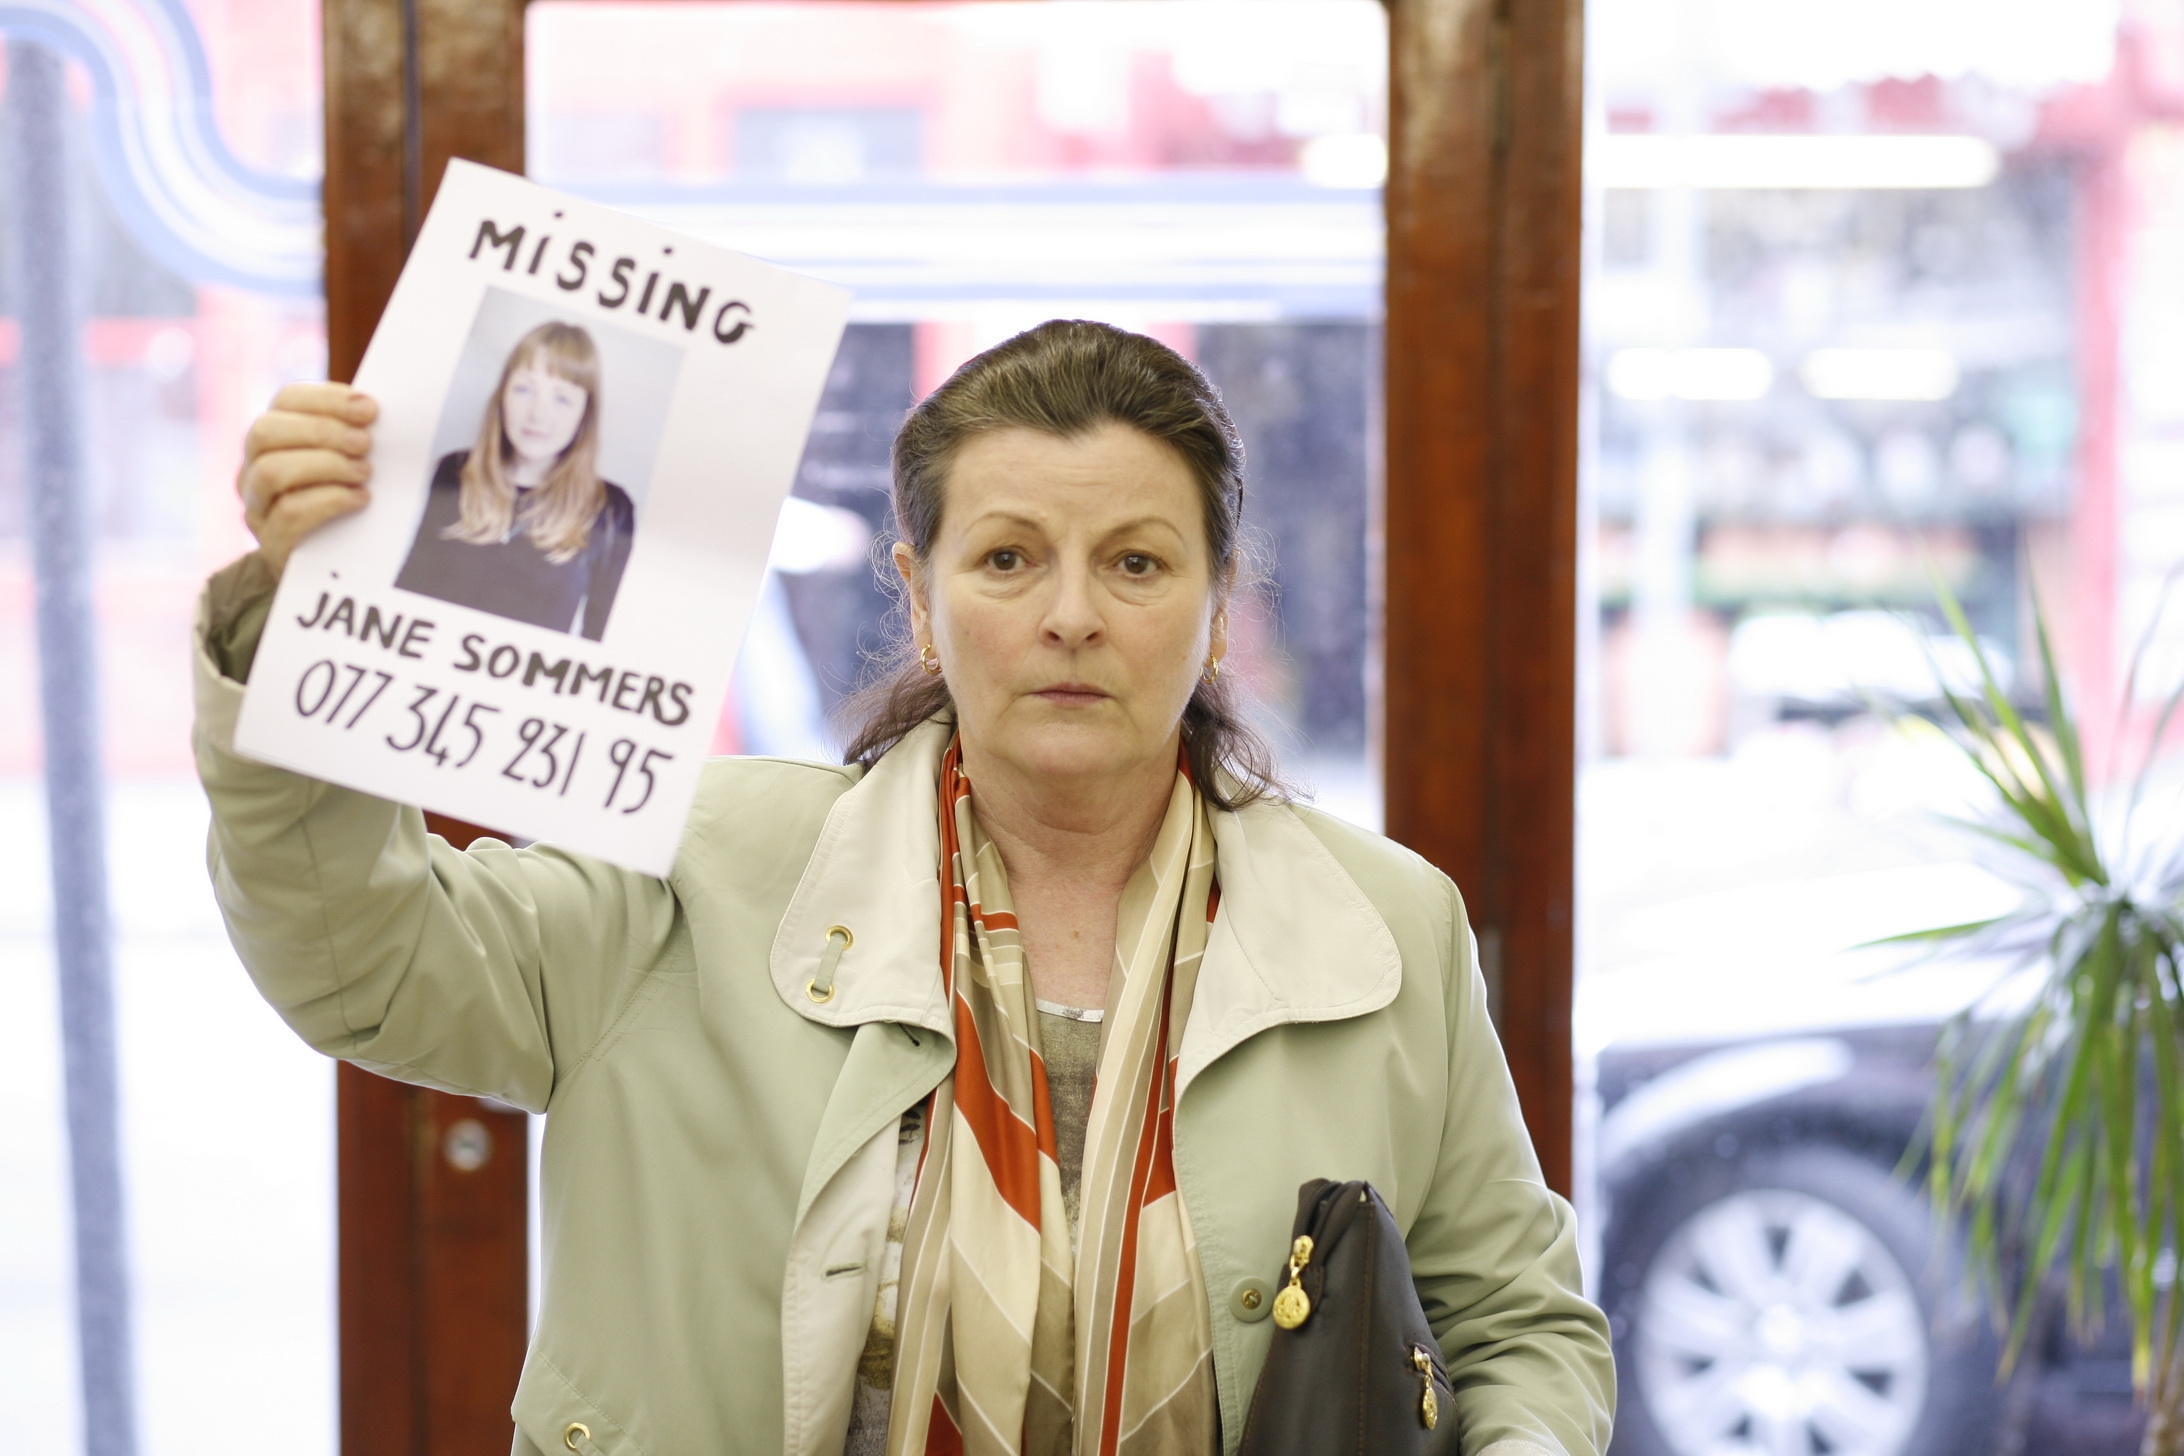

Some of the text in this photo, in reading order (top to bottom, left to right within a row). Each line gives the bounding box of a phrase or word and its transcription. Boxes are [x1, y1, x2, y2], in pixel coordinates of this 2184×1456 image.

[295, 659, 676, 815] 077 345 231 95
[452, 633, 694, 728] SOMMERS
